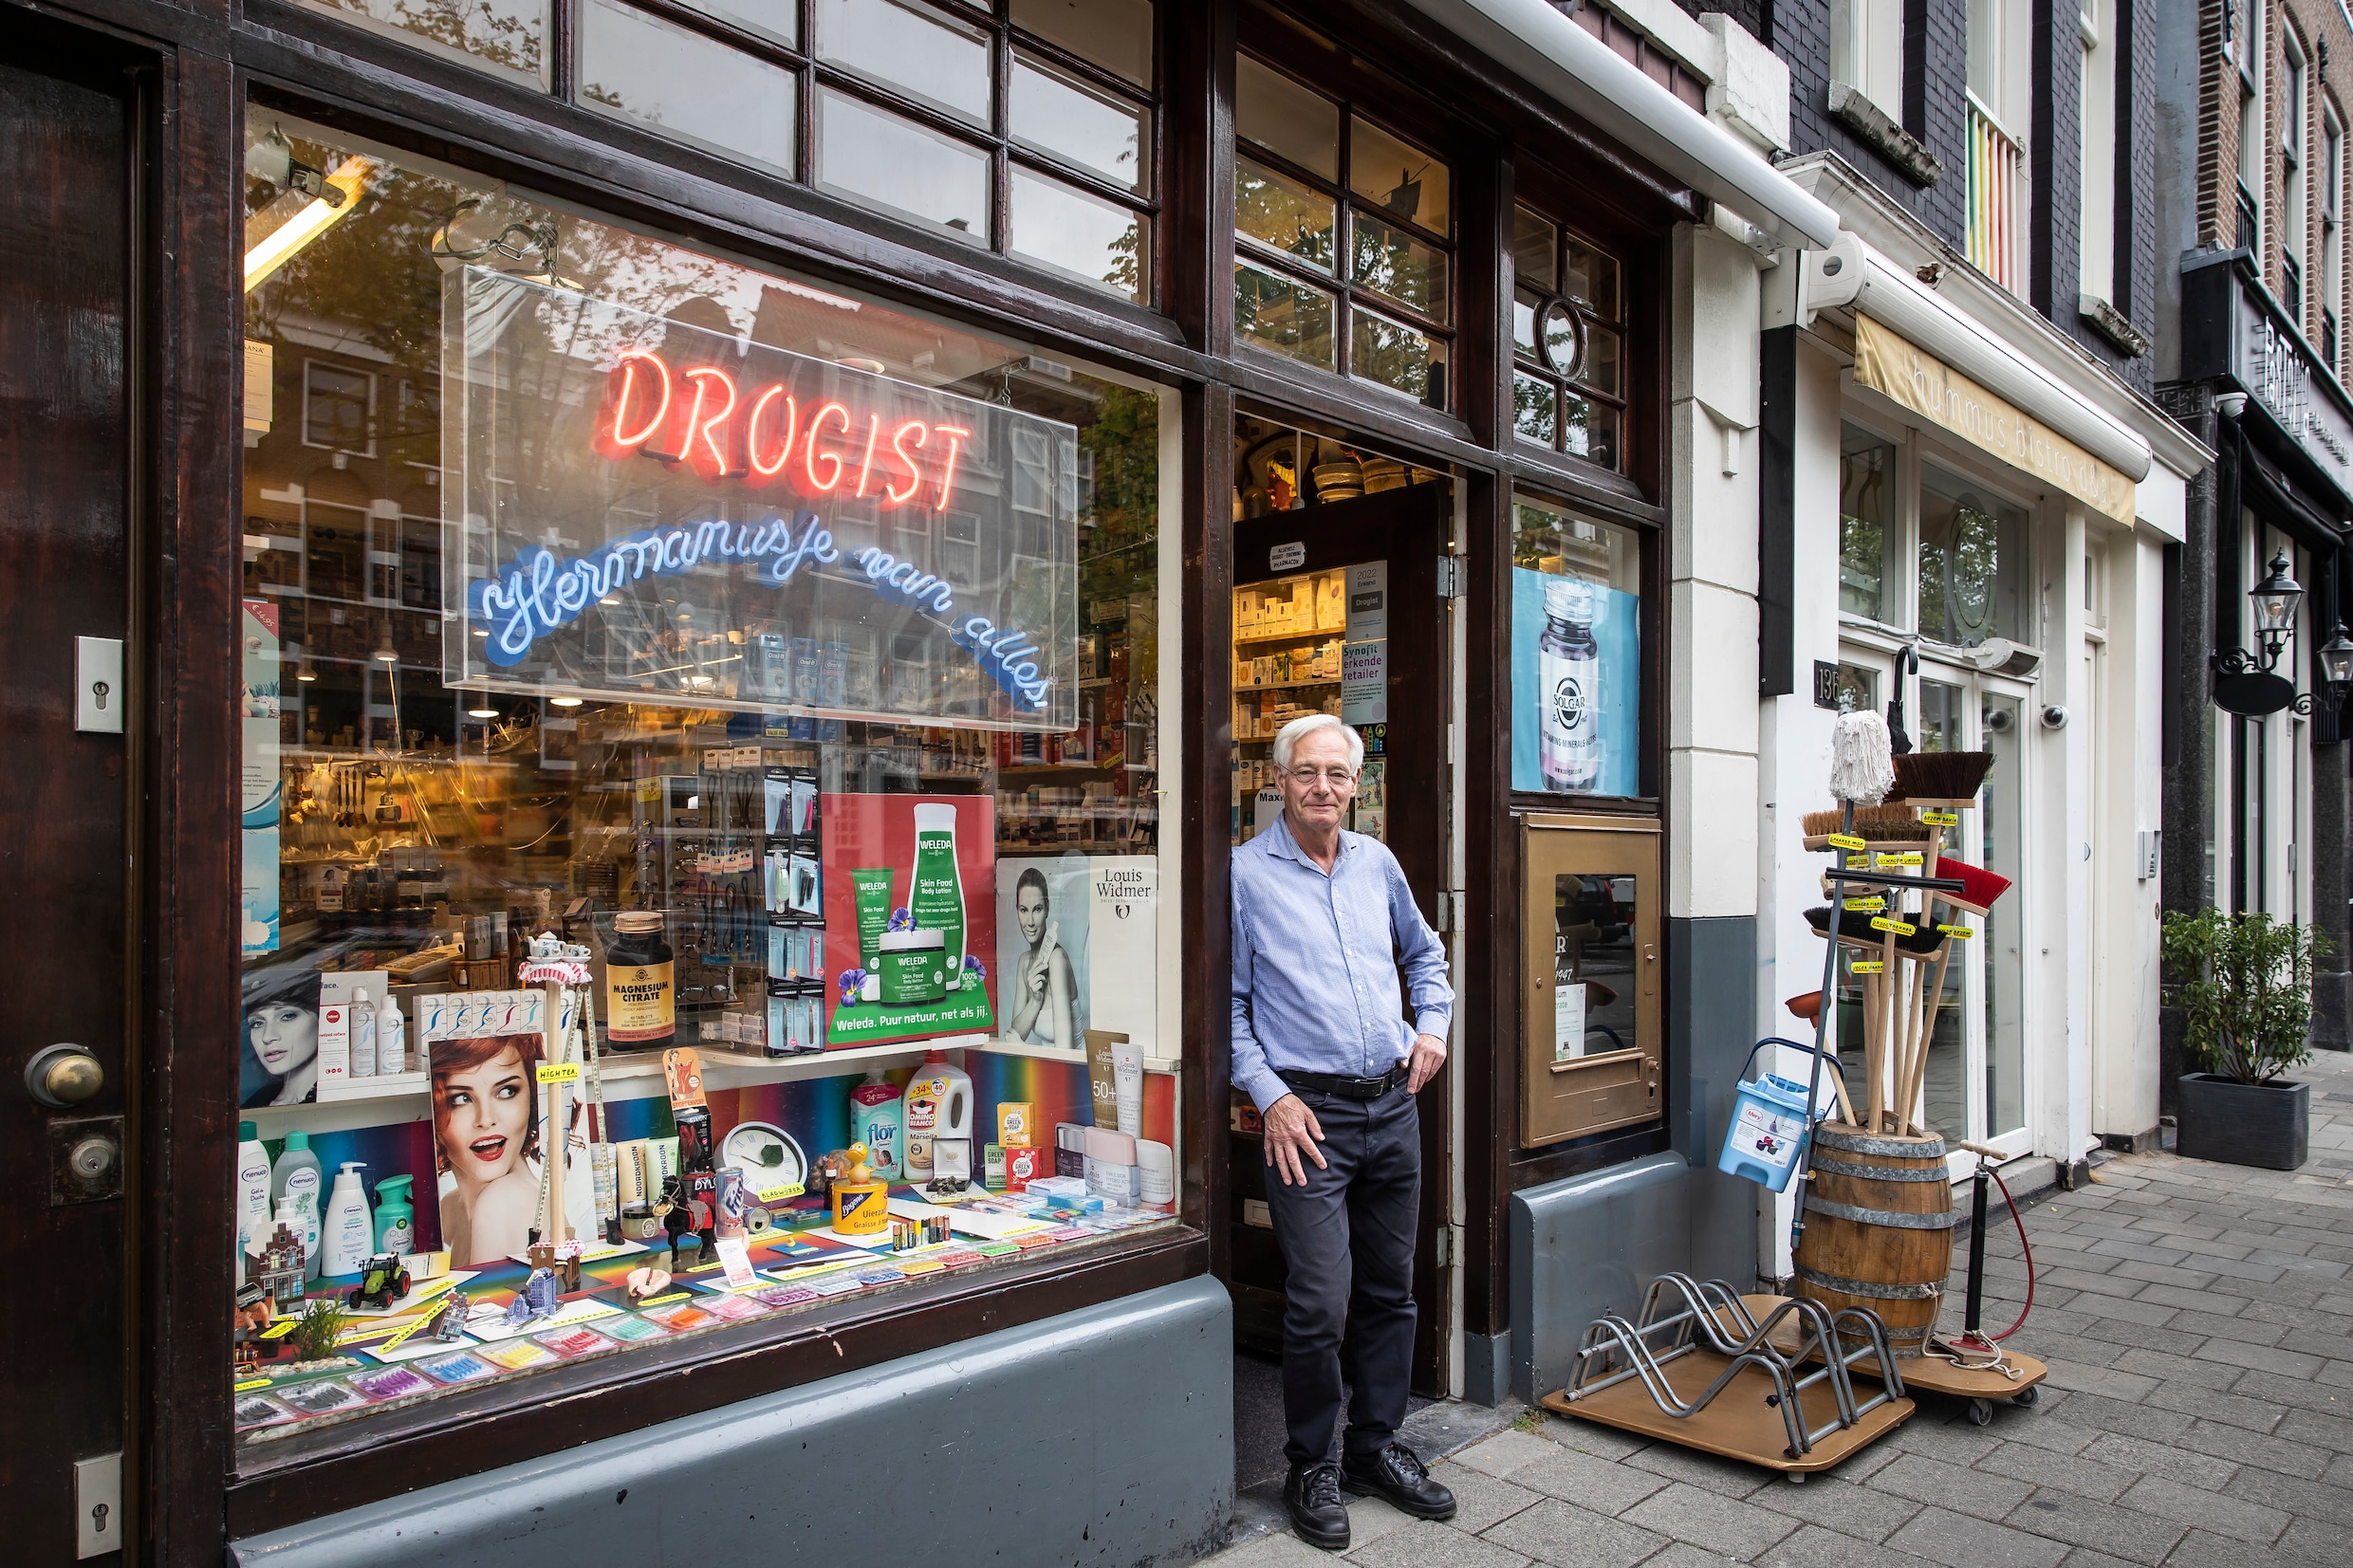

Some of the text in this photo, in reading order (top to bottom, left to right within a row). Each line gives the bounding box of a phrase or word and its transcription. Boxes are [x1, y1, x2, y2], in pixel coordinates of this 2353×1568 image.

[612, 348, 972, 512] DROGIST
[1910, 354, 2109, 507] hummus bistro d&a
[1357, 569, 1377, 580] 2022
[1357, 580, 1377, 588] Erkend
[1356, 597, 1379, 606] Drogist
[854, 544, 953, 613] van
[963, 615, 1050, 710] alles
[1343, 645, 1378, 658] Synofit
[1343, 655, 1382, 669] erkende
[1343, 669, 1380, 681] retailer
[1819, 668, 1840, 702] 136
[1553, 693, 1585, 710] SOLGAR
[919, 839, 953, 851] WELEDA
[1104, 868, 1142, 882] Louis
[860, 882, 887, 891] WELEDA
[936, 878, 953, 887] Food
[1096, 881, 1151, 897] Widmer
[898, 956, 928, 967] WELEDA
[961, 971, 978, 981] 100%
[613, 981, 669, 994] MAGNESIUM
[622, 991, 660, 1002] CITRATE
[836, 1005, 989, 1032] Weleda. Puur natuur, net als jij.
[1117, 1066, 1139, 1075] Widmer
[1092, 1079, 1117, 1099] 50+
[865, 1094, 875, 1102] 24
[1747, 1111, 1762, 1120] Mery
[867, 1123, 898, 1146] flor
[246, 1170, 267, 1178] nenuco
[631, 1146, 642, 1197] NOORDKROON
[292, 1176, 315, 1185] nenuco
[842, 1193, 865, 1217] Bogena
[853, 1221, 877, 1229] Graisse
[389, 1228, 413, 1238] pure
